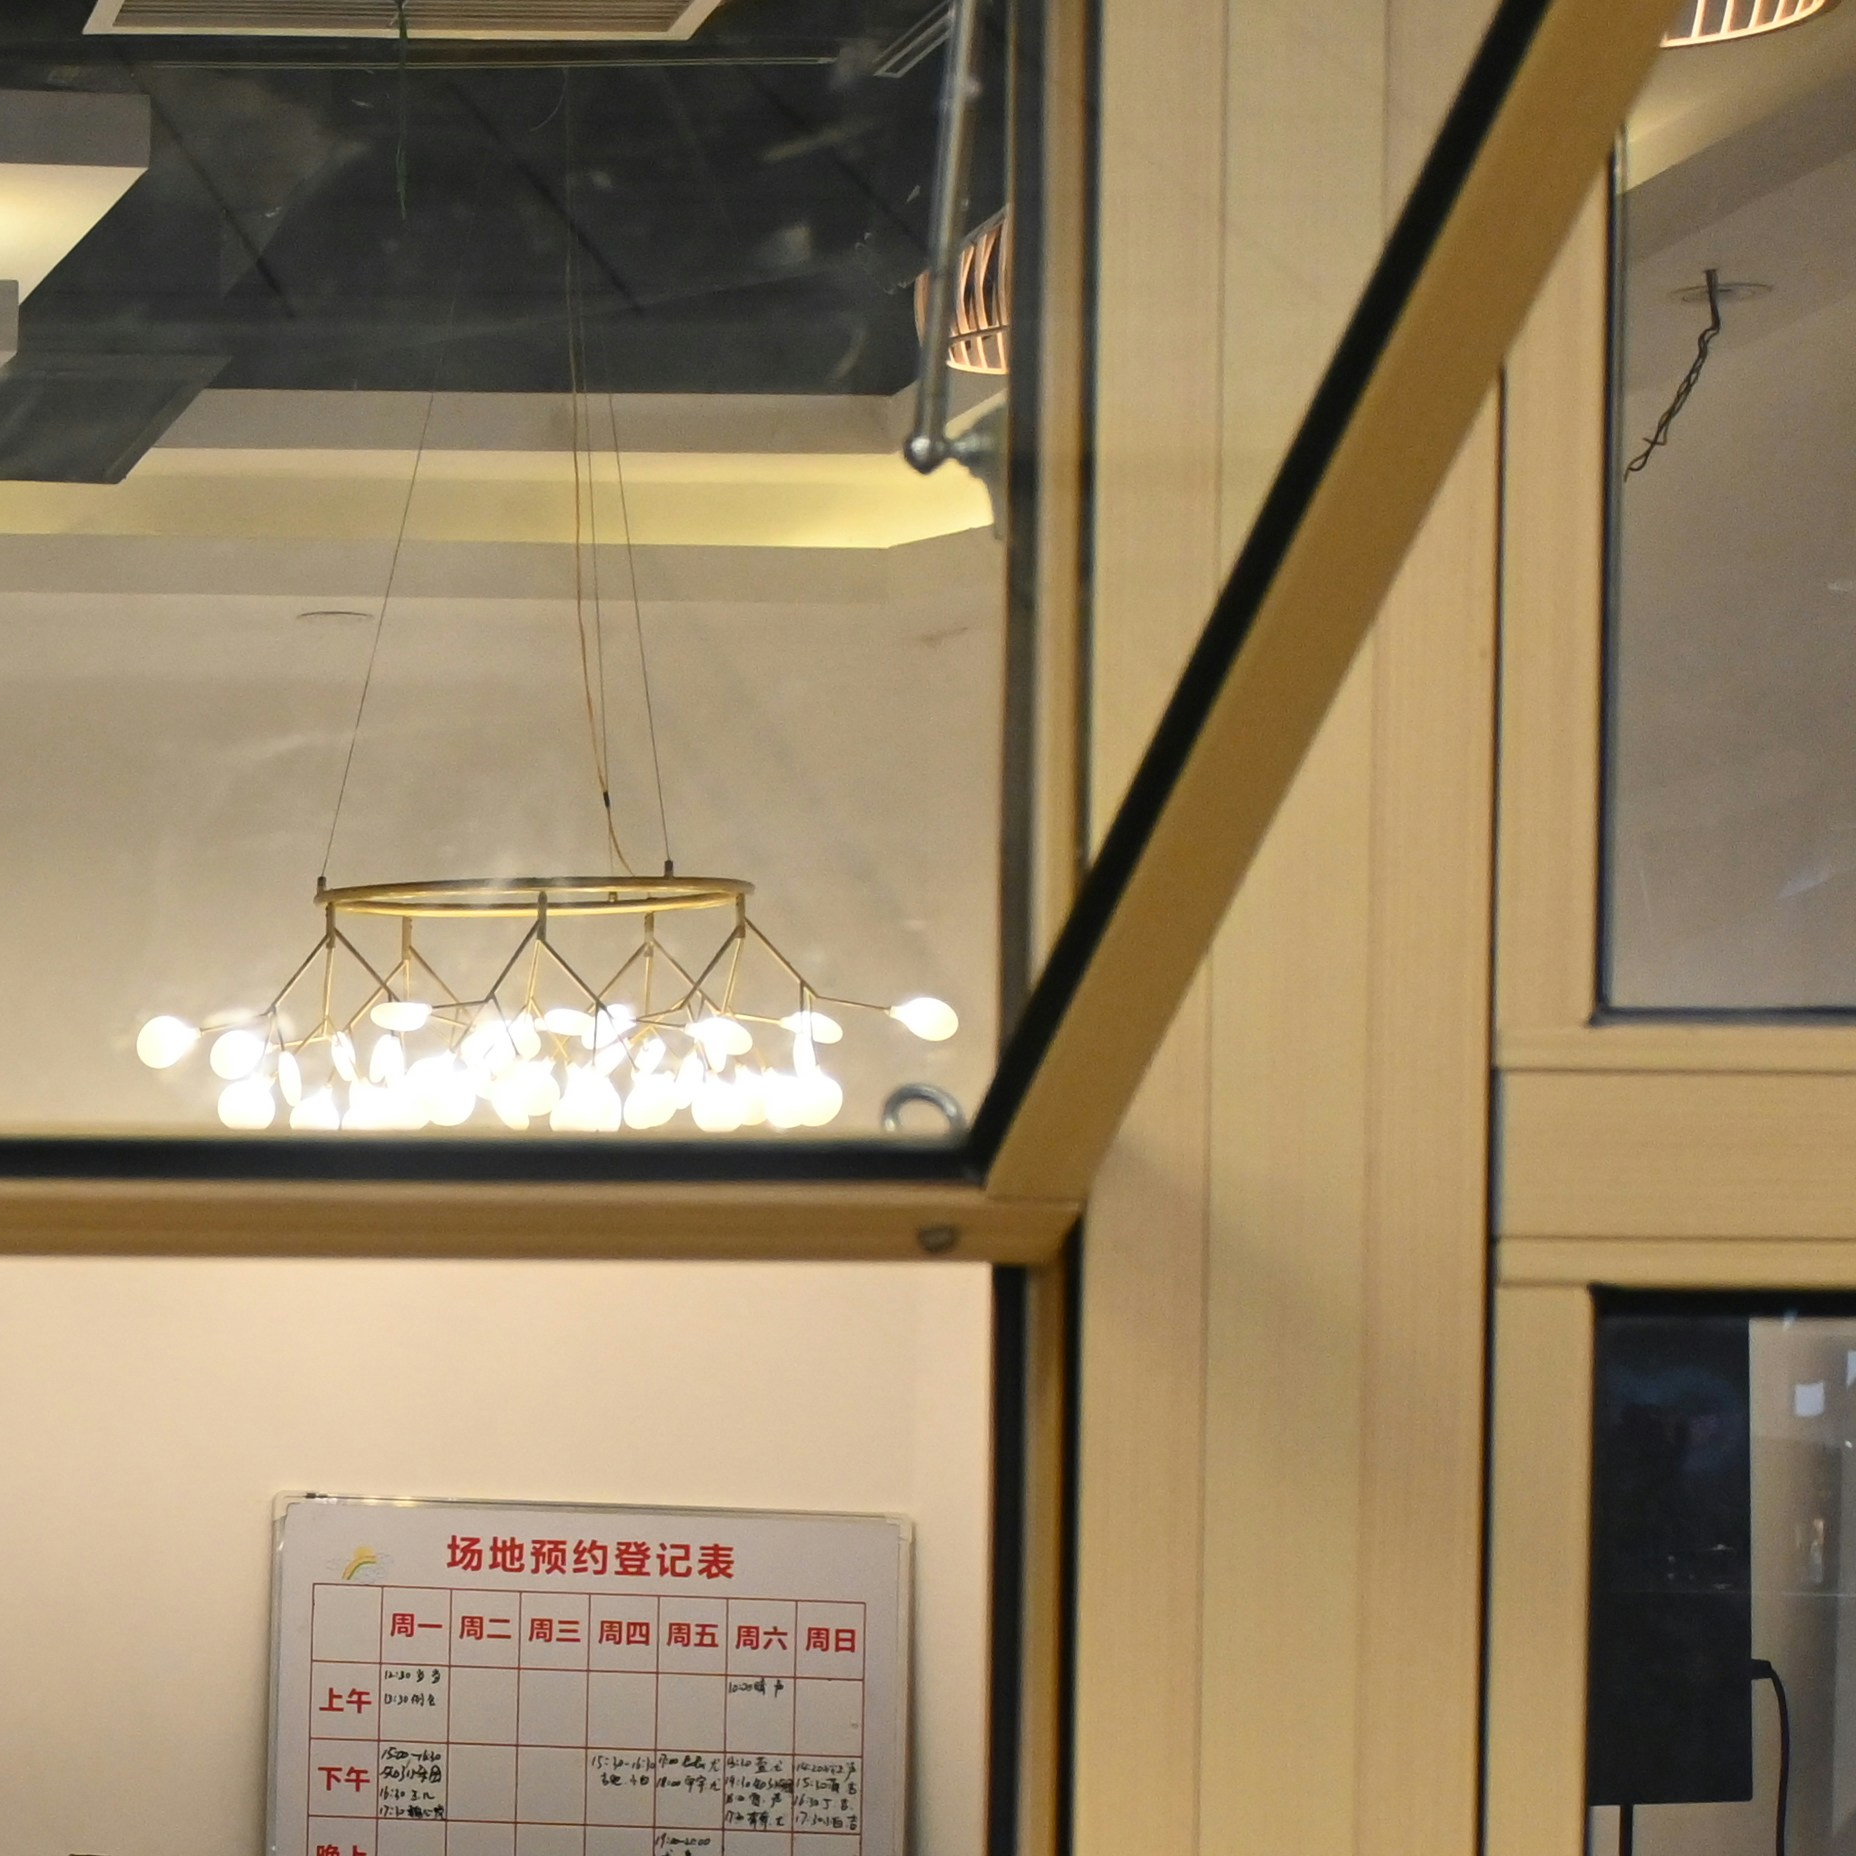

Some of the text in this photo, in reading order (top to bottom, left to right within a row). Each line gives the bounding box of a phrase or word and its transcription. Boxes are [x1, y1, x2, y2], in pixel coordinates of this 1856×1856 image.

[446, 1534, 736, 1580] 场地预约登记表
[390, 1611, 858, 1653] 周一 周二 周三 周四 周五 周六 周日
[319, 1687, 373, 1714] 上午
[318, 1764, 371, 1793] 下午
